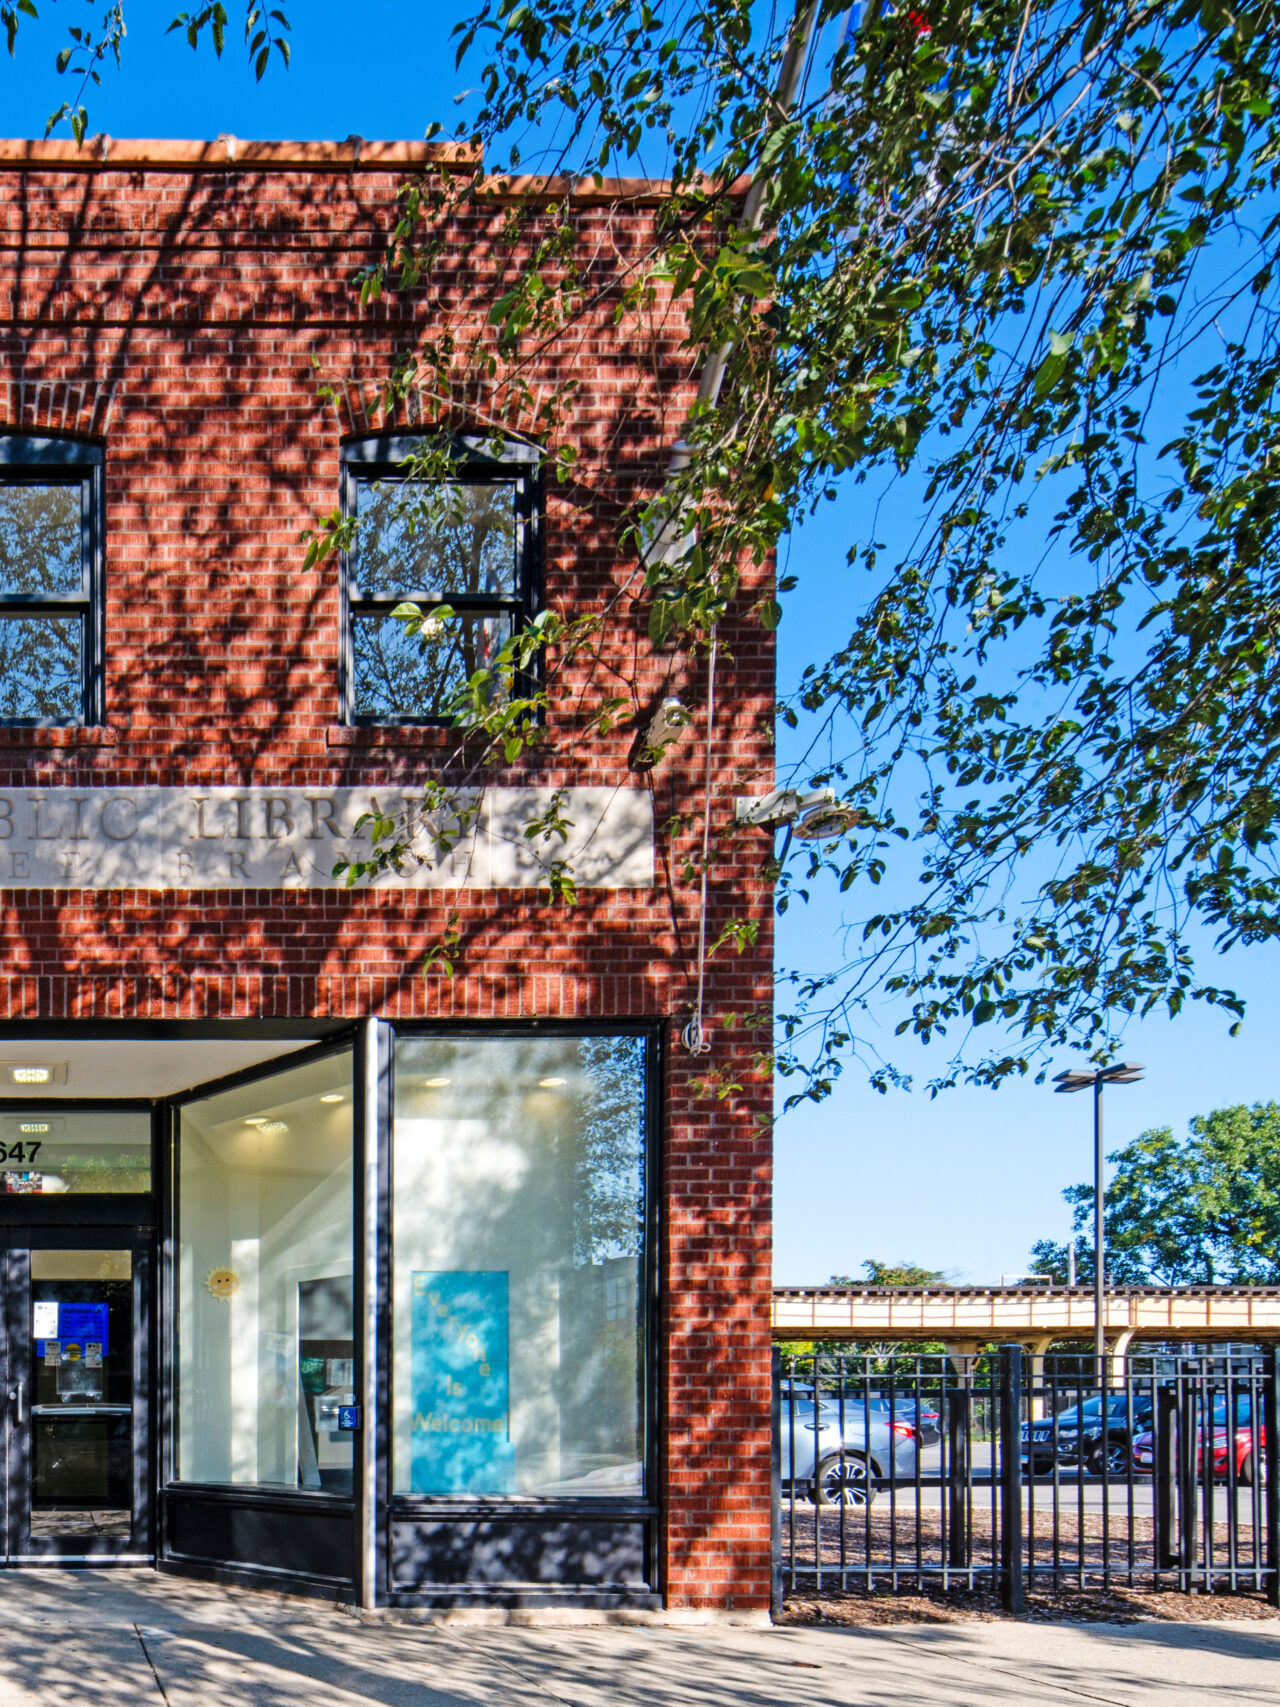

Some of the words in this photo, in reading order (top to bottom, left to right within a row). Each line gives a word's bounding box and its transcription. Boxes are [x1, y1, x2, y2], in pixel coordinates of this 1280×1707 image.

[188, 796, 480, 841] LIBRARY
[413, 1275, 491, 1378] Everyone
[446, 1374, 462, 1396] Is
[410, 1411, 505, 1432] Welcome
